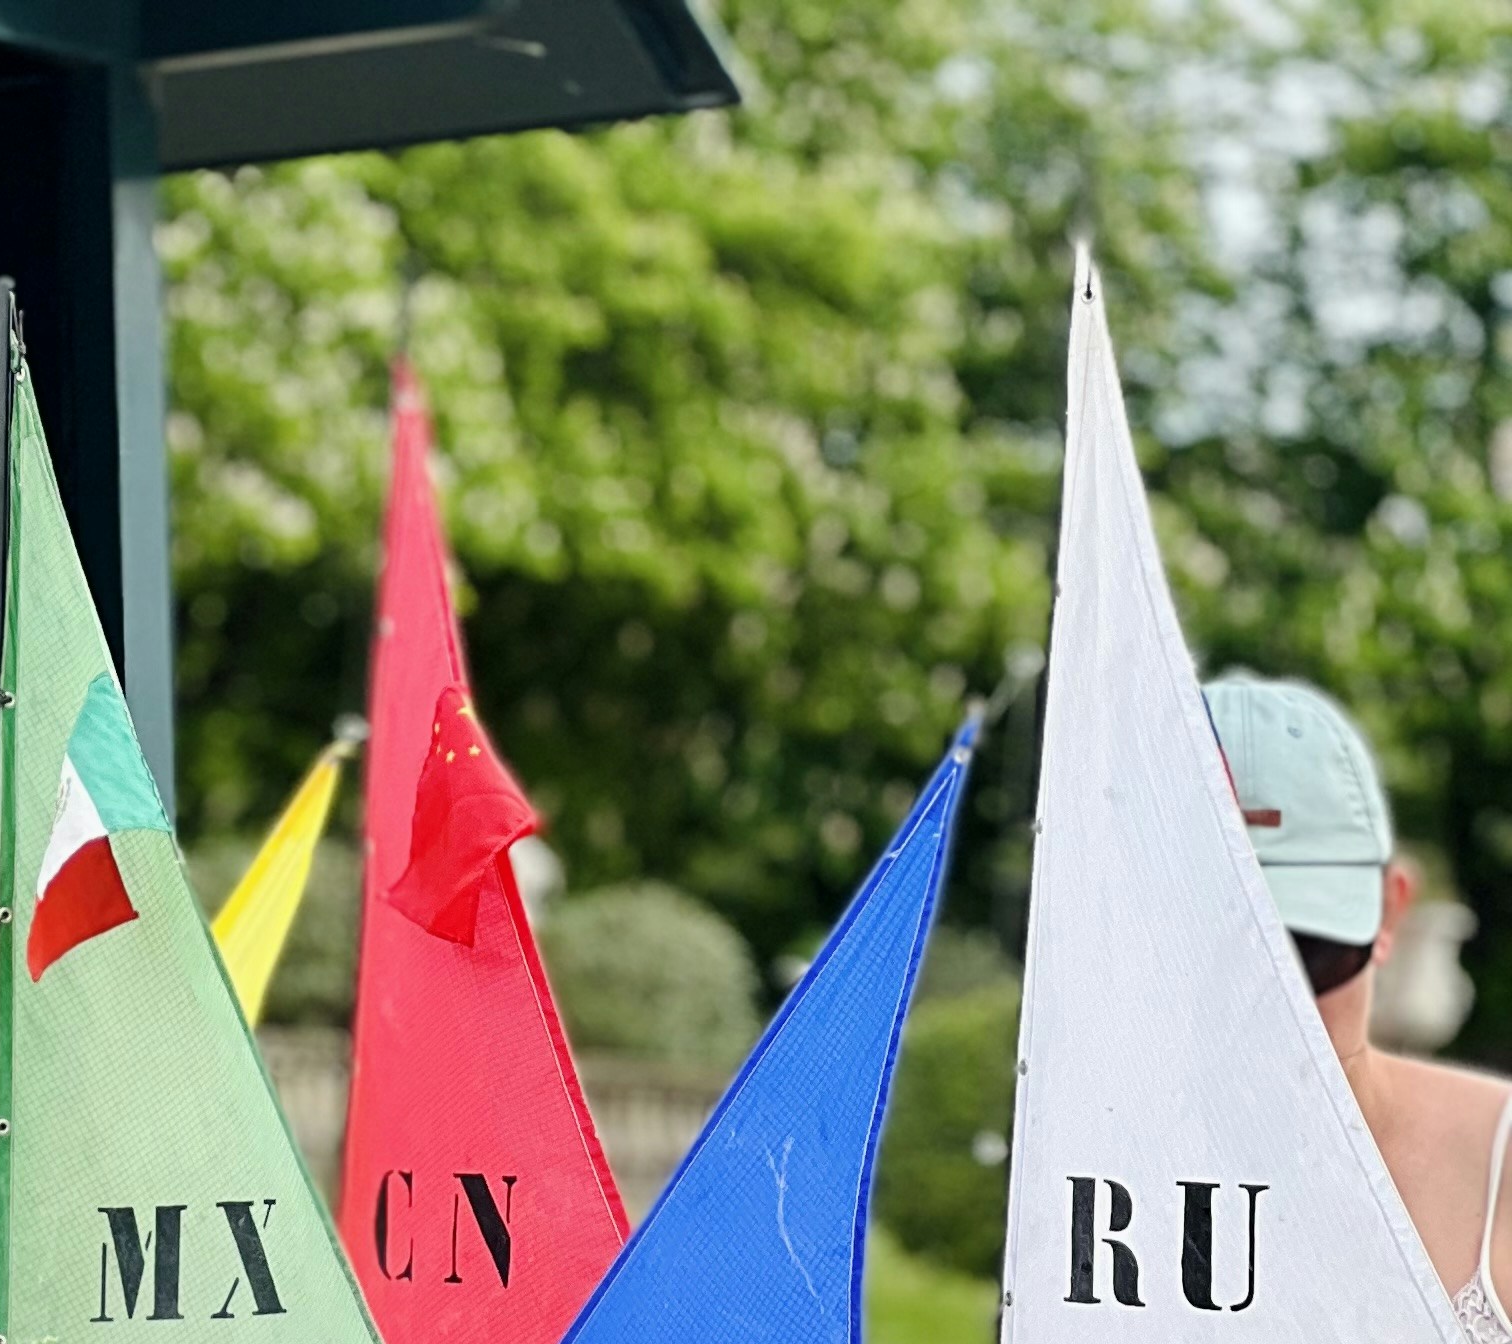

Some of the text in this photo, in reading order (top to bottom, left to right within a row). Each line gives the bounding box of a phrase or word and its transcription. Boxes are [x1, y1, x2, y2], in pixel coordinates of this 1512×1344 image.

[89, 1199, 287, 1322] MX
[375, 1169, 517, 1289] CN
[1063, 1176, 1270, 1312] RU
